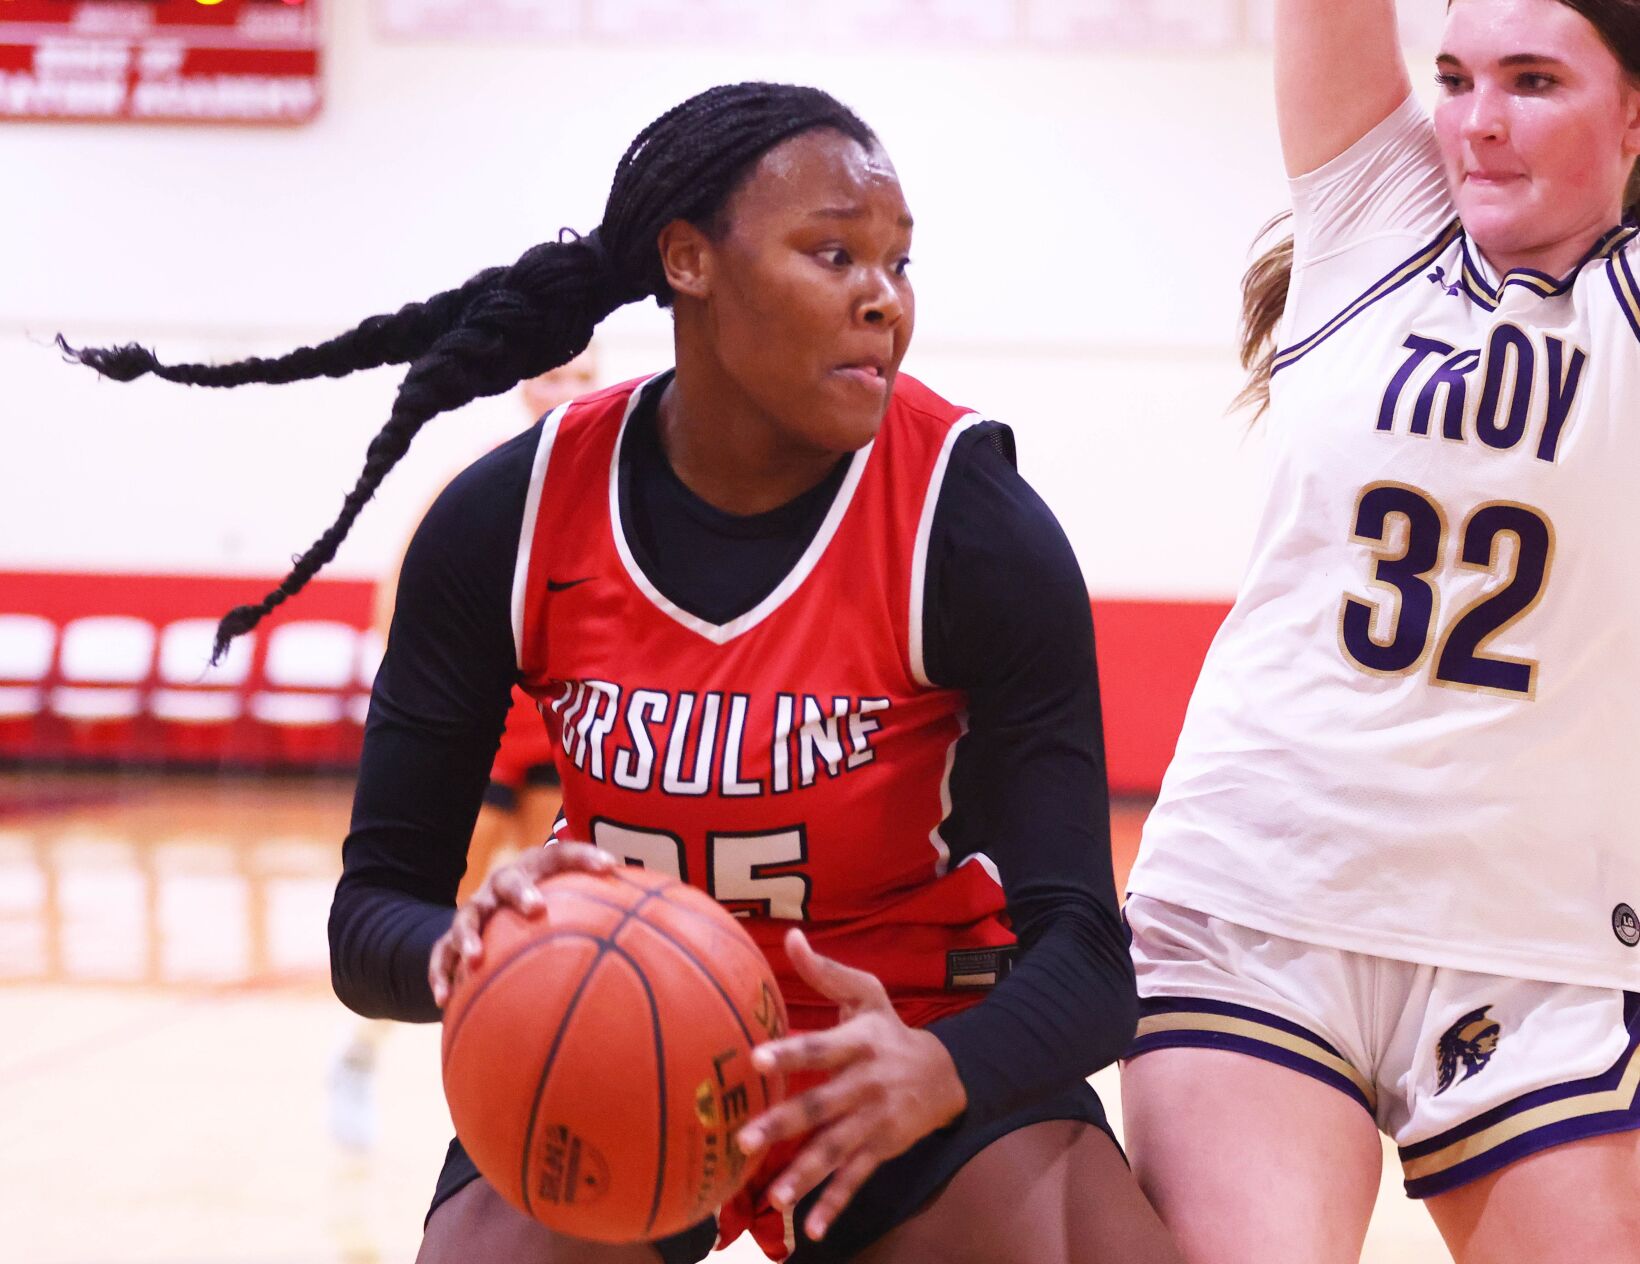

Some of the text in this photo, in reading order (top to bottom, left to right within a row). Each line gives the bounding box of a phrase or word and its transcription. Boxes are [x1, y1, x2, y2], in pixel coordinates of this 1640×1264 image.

[1374, 320, 1590, 464] TROY
[1337, 479, 1556, 702] 32
[550, 680, 890, 796] URSULINE
